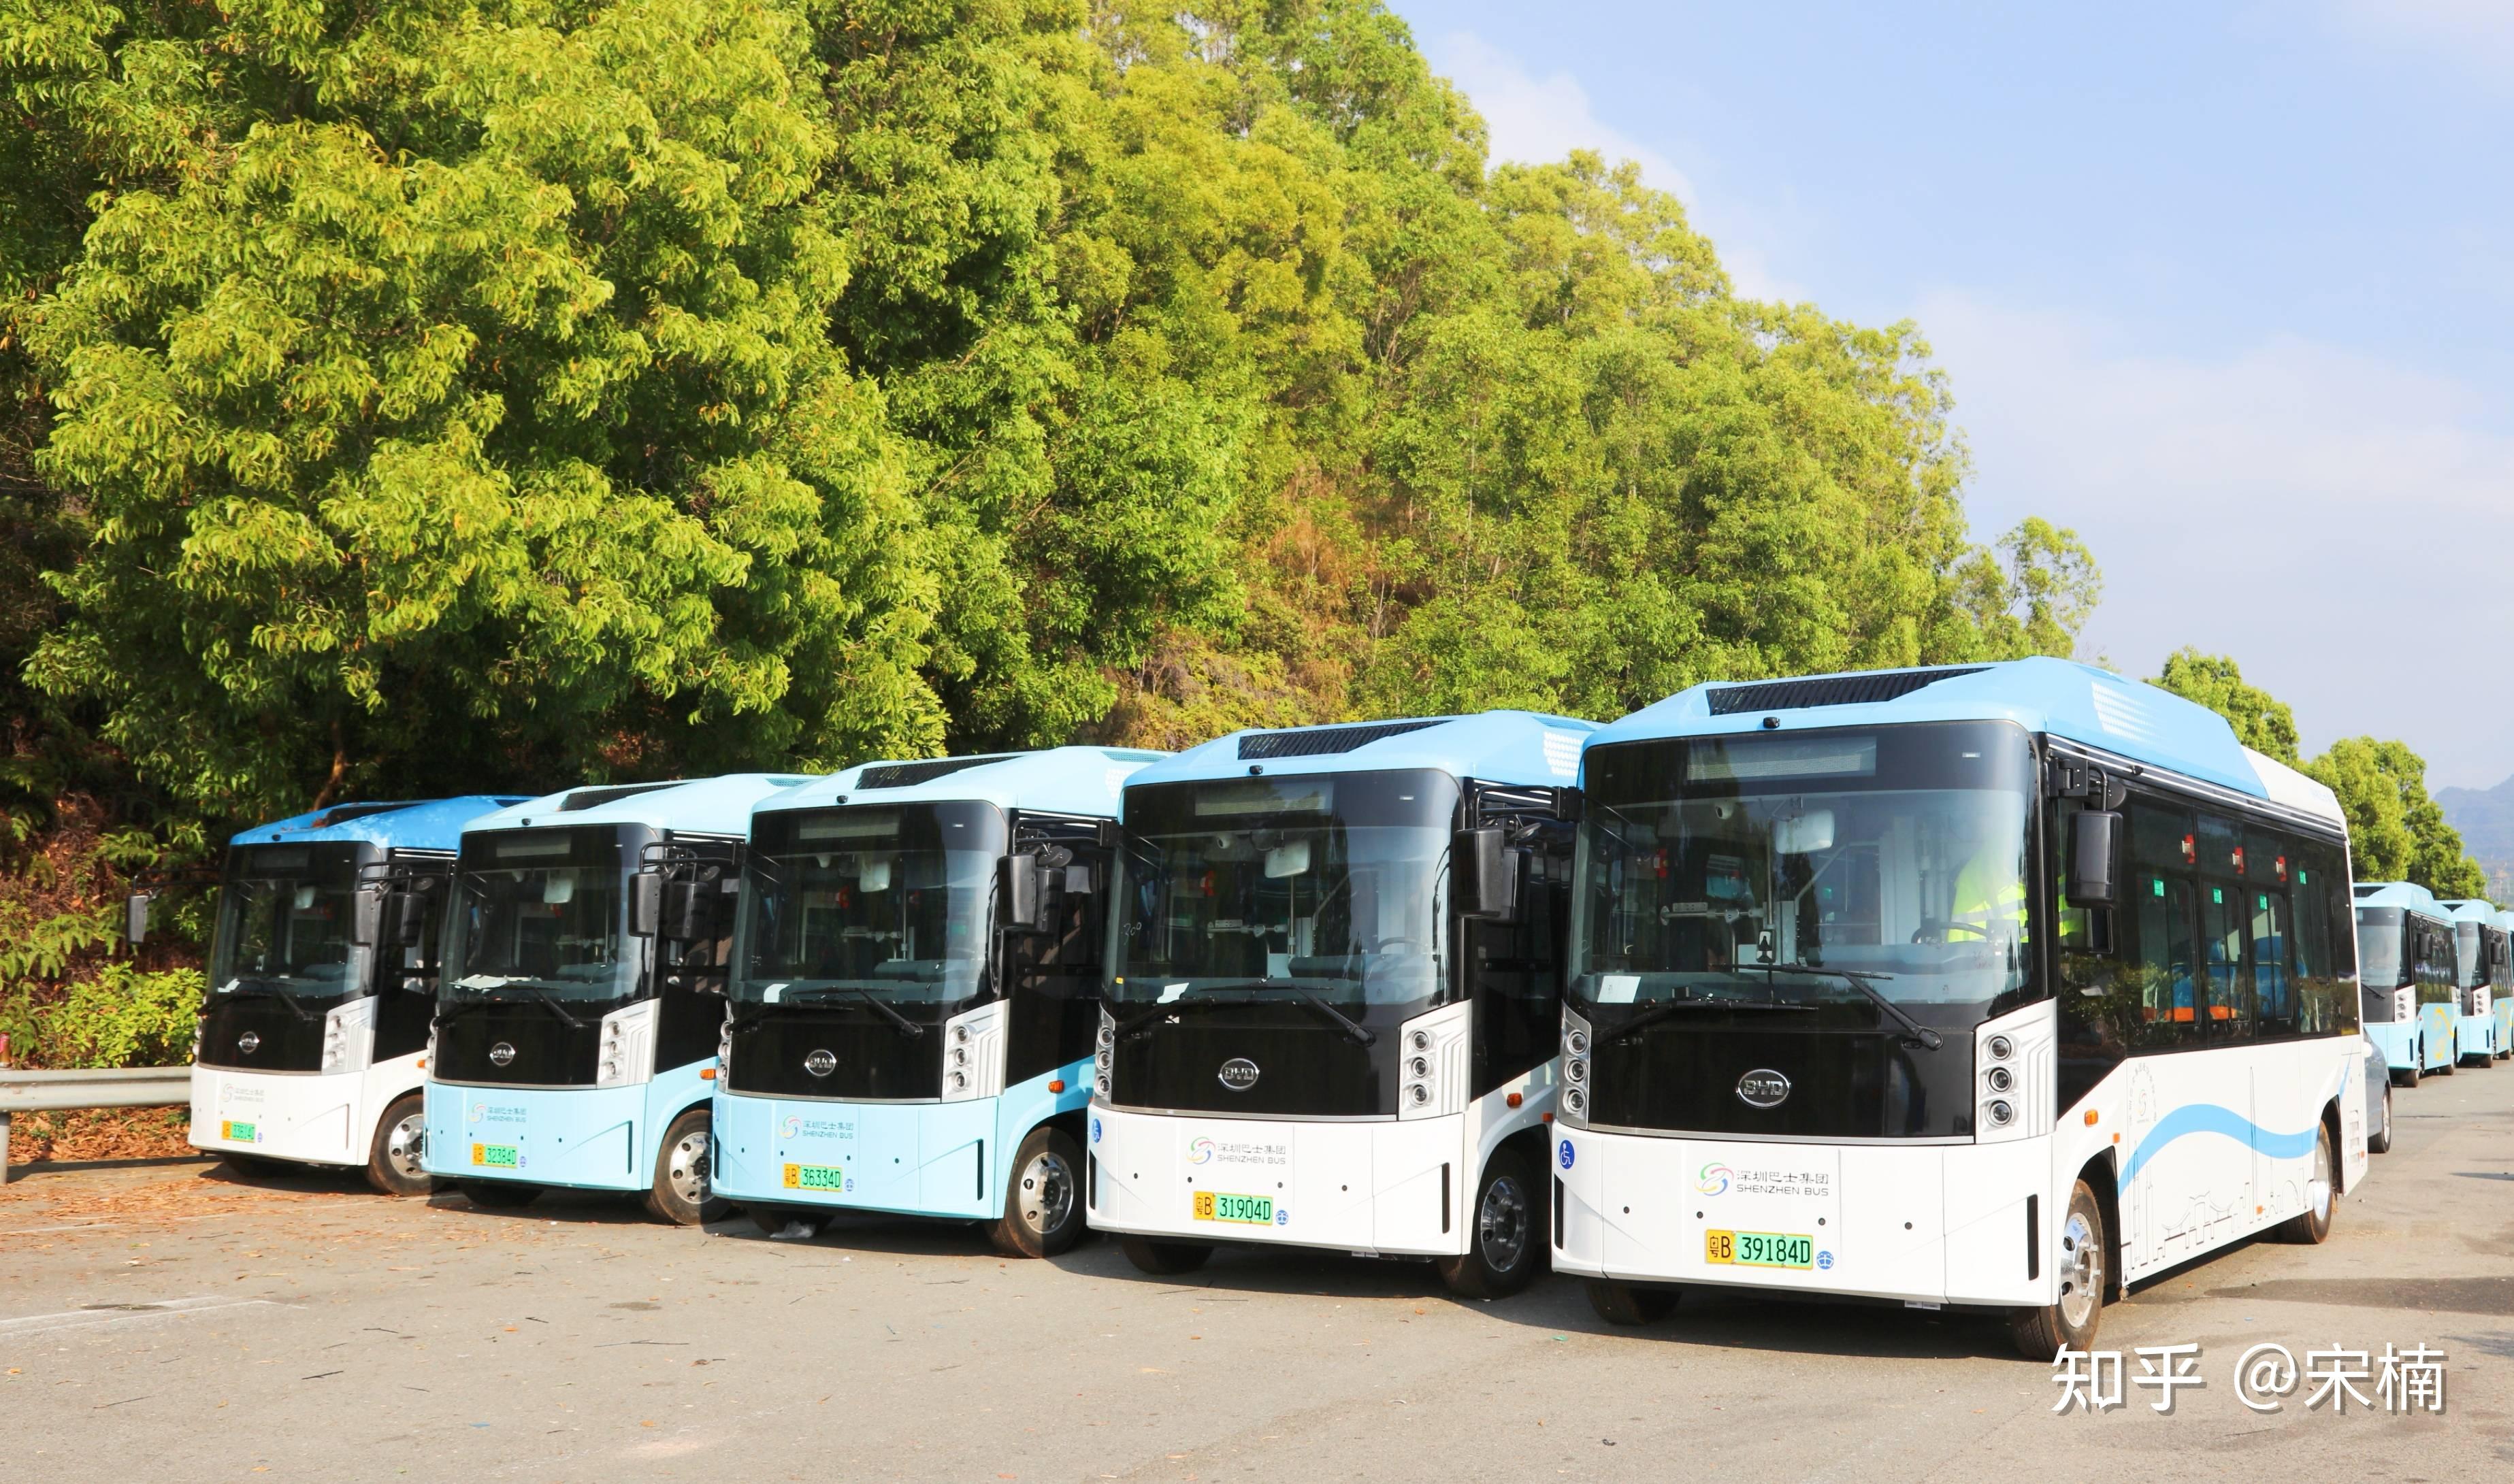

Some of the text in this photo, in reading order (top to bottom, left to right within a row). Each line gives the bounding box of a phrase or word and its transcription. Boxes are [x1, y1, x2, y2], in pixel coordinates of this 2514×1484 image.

[1743, 1080, 1784, 1095] BYD
[802, 1130, 838, 1138] SHENZHEN
[1218, 1143, 1286, 1155] 深圳巴士集团
[1217, 1155, 1286, 1165] SHENZHEN BUS
[1736, 1170, 1829, 1185] 深圳巴士集团
[1736, 1184, 1829, 1196] SHENZHEN BUS
